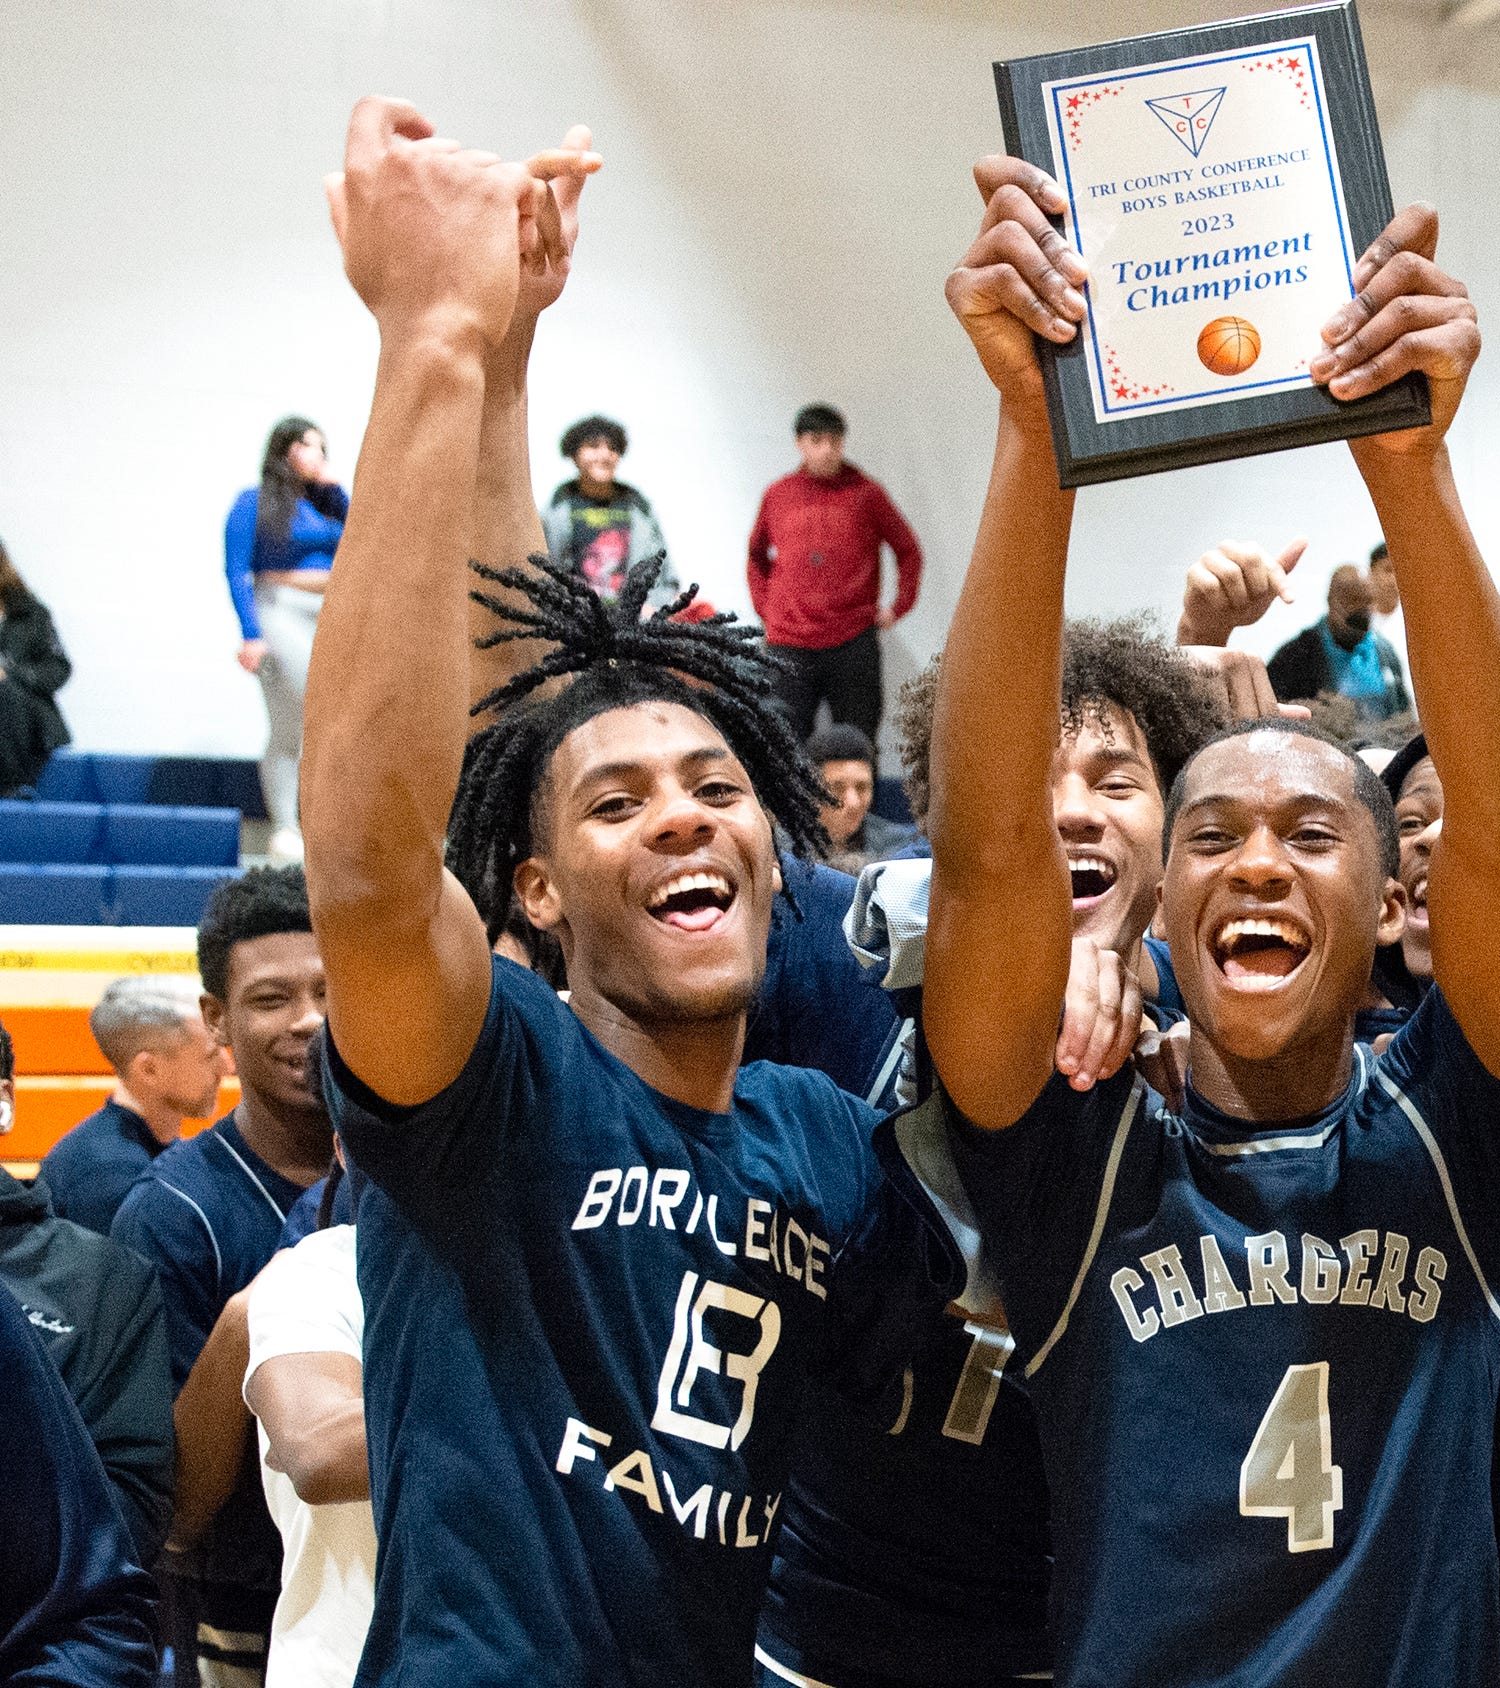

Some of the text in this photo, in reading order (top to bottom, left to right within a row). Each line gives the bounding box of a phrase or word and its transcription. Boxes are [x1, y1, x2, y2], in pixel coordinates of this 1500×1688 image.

[1176, 118, 1207, 133] C C
[1182, 97, 1192, 109] T
[1087, 148, 1312, 199] TRI COUNTY CONFERENCE
[1121, 174, 1286, 214] BOYS BASKETBALL
[1181, 213, 1235, 237] 2023
[1111, 232, 1314, 285] Tournament
[1126, 264, 1309, 313] Champions
[1110, 1229, 1448, 1343] CHARGERS
[1239, 1360, 1344, 1554] 4
[555, 1416, 782, 1549] FAMILY
